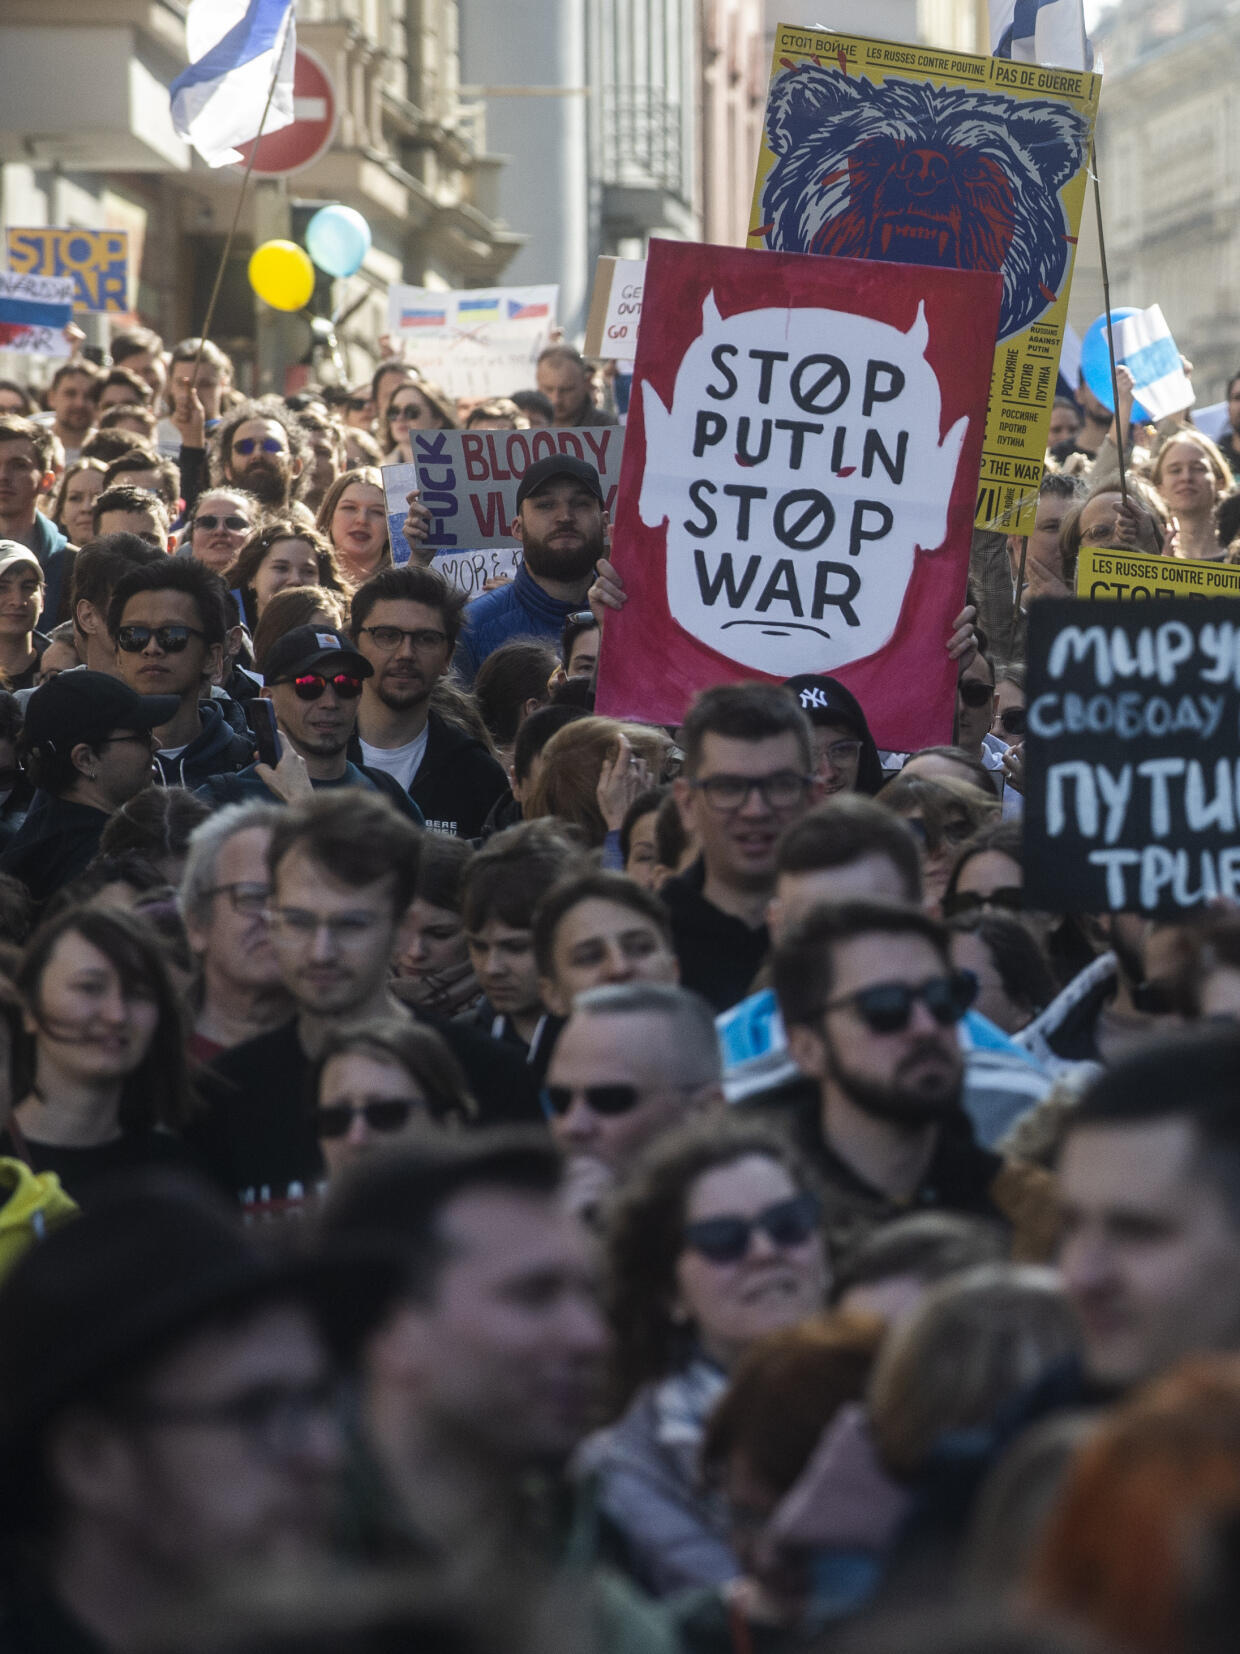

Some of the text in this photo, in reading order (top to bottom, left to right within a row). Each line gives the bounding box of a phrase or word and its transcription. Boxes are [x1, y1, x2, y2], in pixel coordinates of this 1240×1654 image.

[781, 34, 857, 56] СТОП ВОЙНЕ
[866, 48, 985, 76] LES RUSSES CONTRE POUTINE
[996, 66, 1082, 93] PAS DE GUERRE
[9, 229, 127, 276] STOP
[72, 270, 127, 311] AR
[608, 325, 628, 339] GO
[1028, 336, 1060, 346] AGAINST
[1027, 344, 1050, 354] PUTIN
[1001, 348, 1019, 396] РОССИЯНЕ
[1018, 363, 1034, 399] ПРОТИВ
[1035, 366, 1052, 401] ПУТИНА
[999, 422, 1027, 434] ПРОТИВ
[1001, 408, 1039, 422] РОССИЯНЕ
[693, 410, 909, 485] PUTIN
[997, 435, 1025, 448] ПУТИНА
[990, 459, 1011, 477] THE
[1014, 463, 1040, 480] WAR
[415, 432, 459, 546] FUCK
[1092, 559, 1112, 574] LES
[1115, 561, 1158, 579] RUSSES
[1161, 567, 1204, 585] CONTRE
[694, 549, 861, 626] WAR
[1047, 621, 1194, 686] МИР
[1028, 692, 1224, 739] СВОБОДУ
